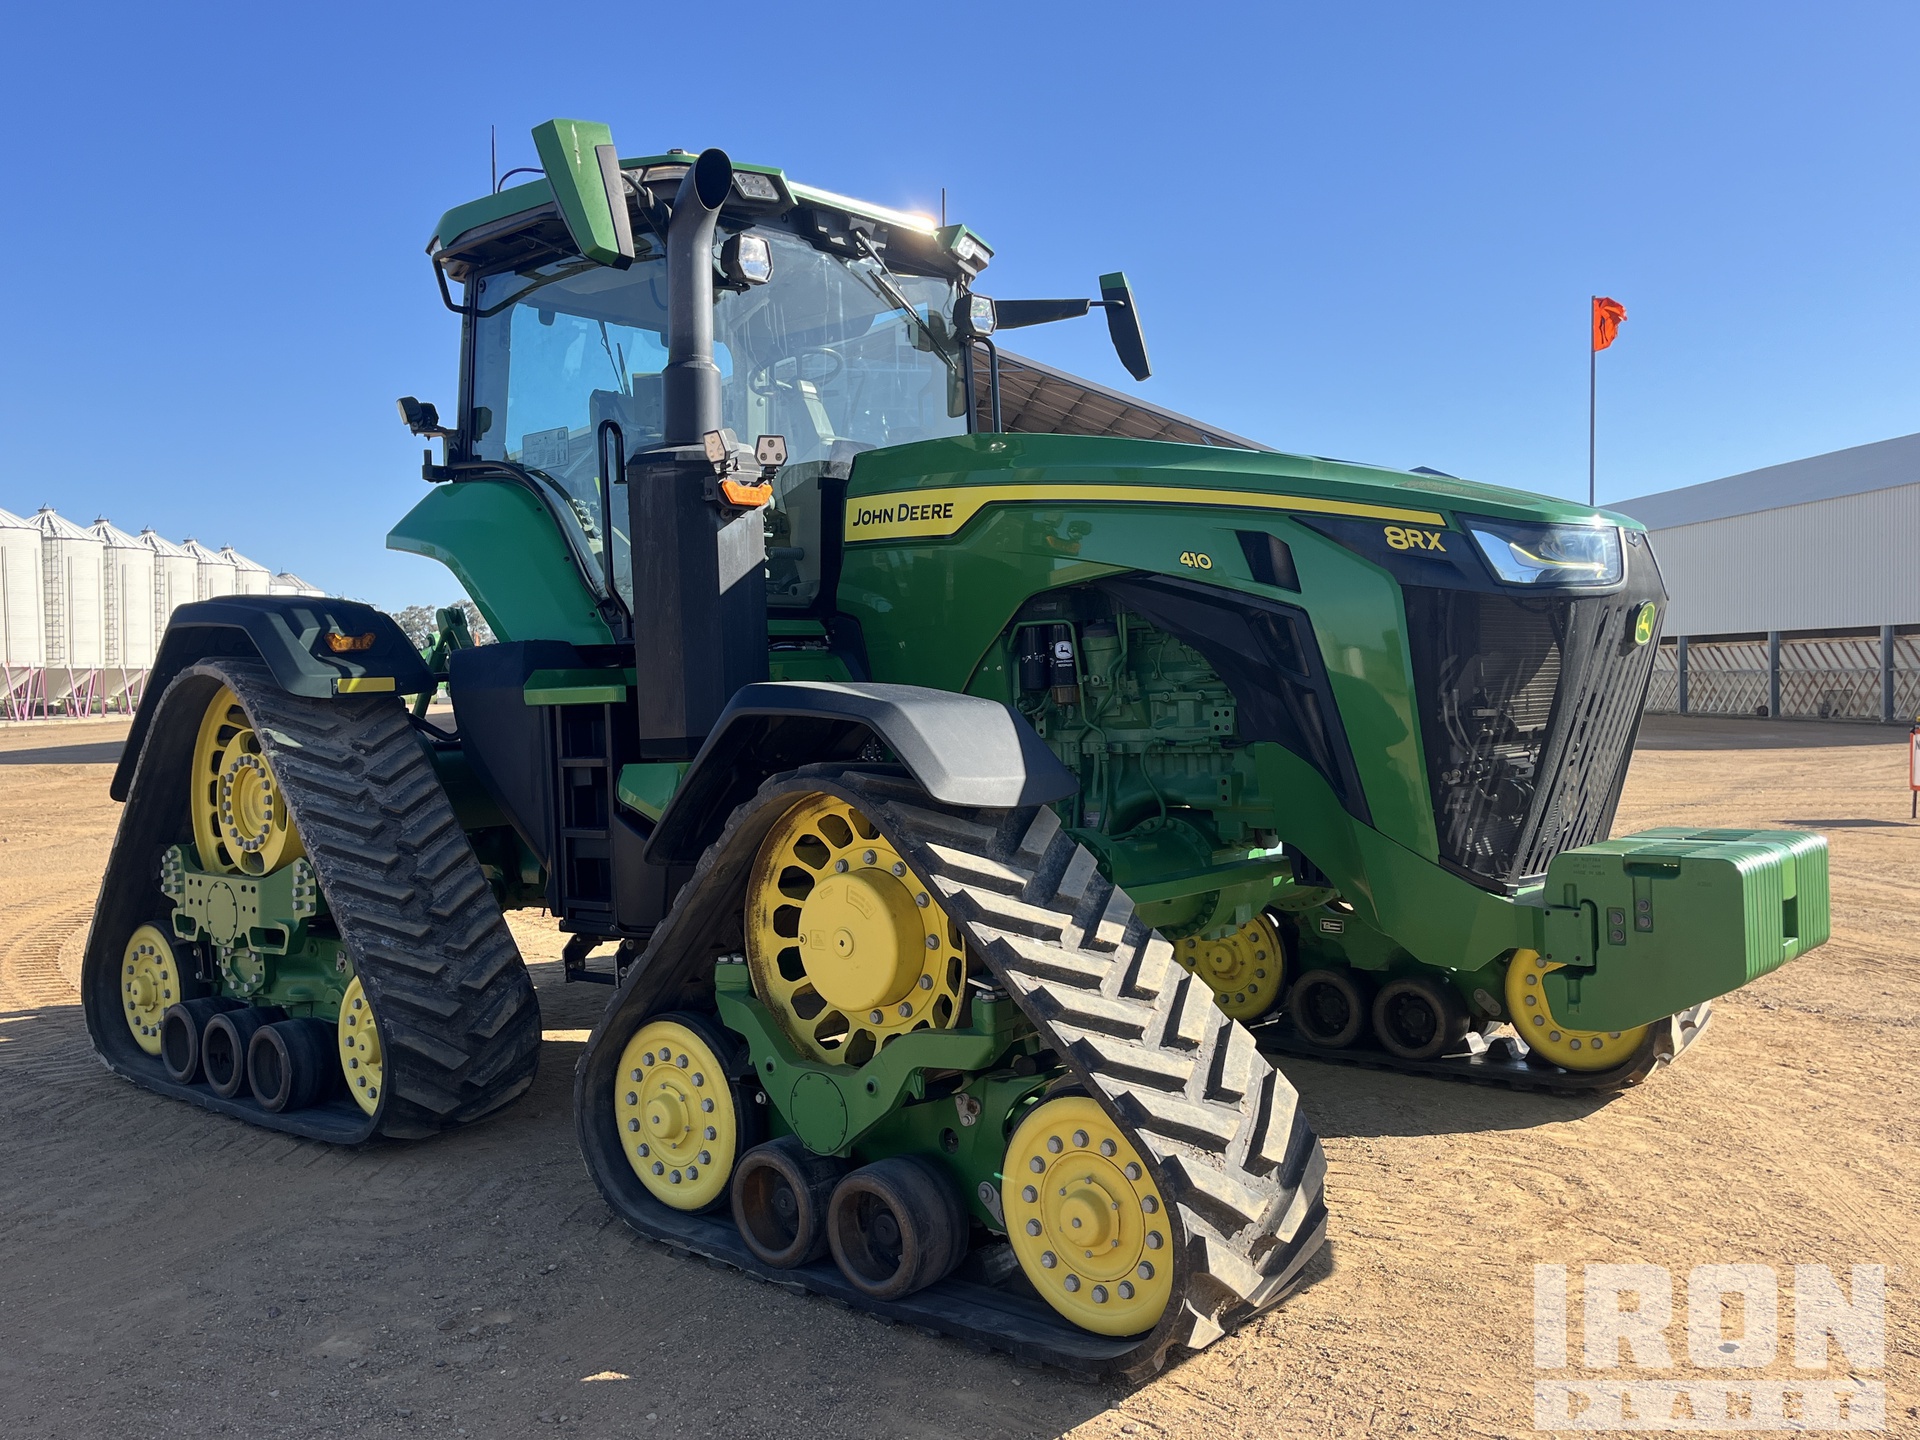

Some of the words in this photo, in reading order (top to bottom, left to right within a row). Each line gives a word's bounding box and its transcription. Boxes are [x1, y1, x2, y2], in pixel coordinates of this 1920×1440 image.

[853, 508, 894, 526] JOHN
[897, 503, 954, 522] DEERE
[1383, 526, 1447, 552] 8RX
[1179, 551, 1213, 570] 410
